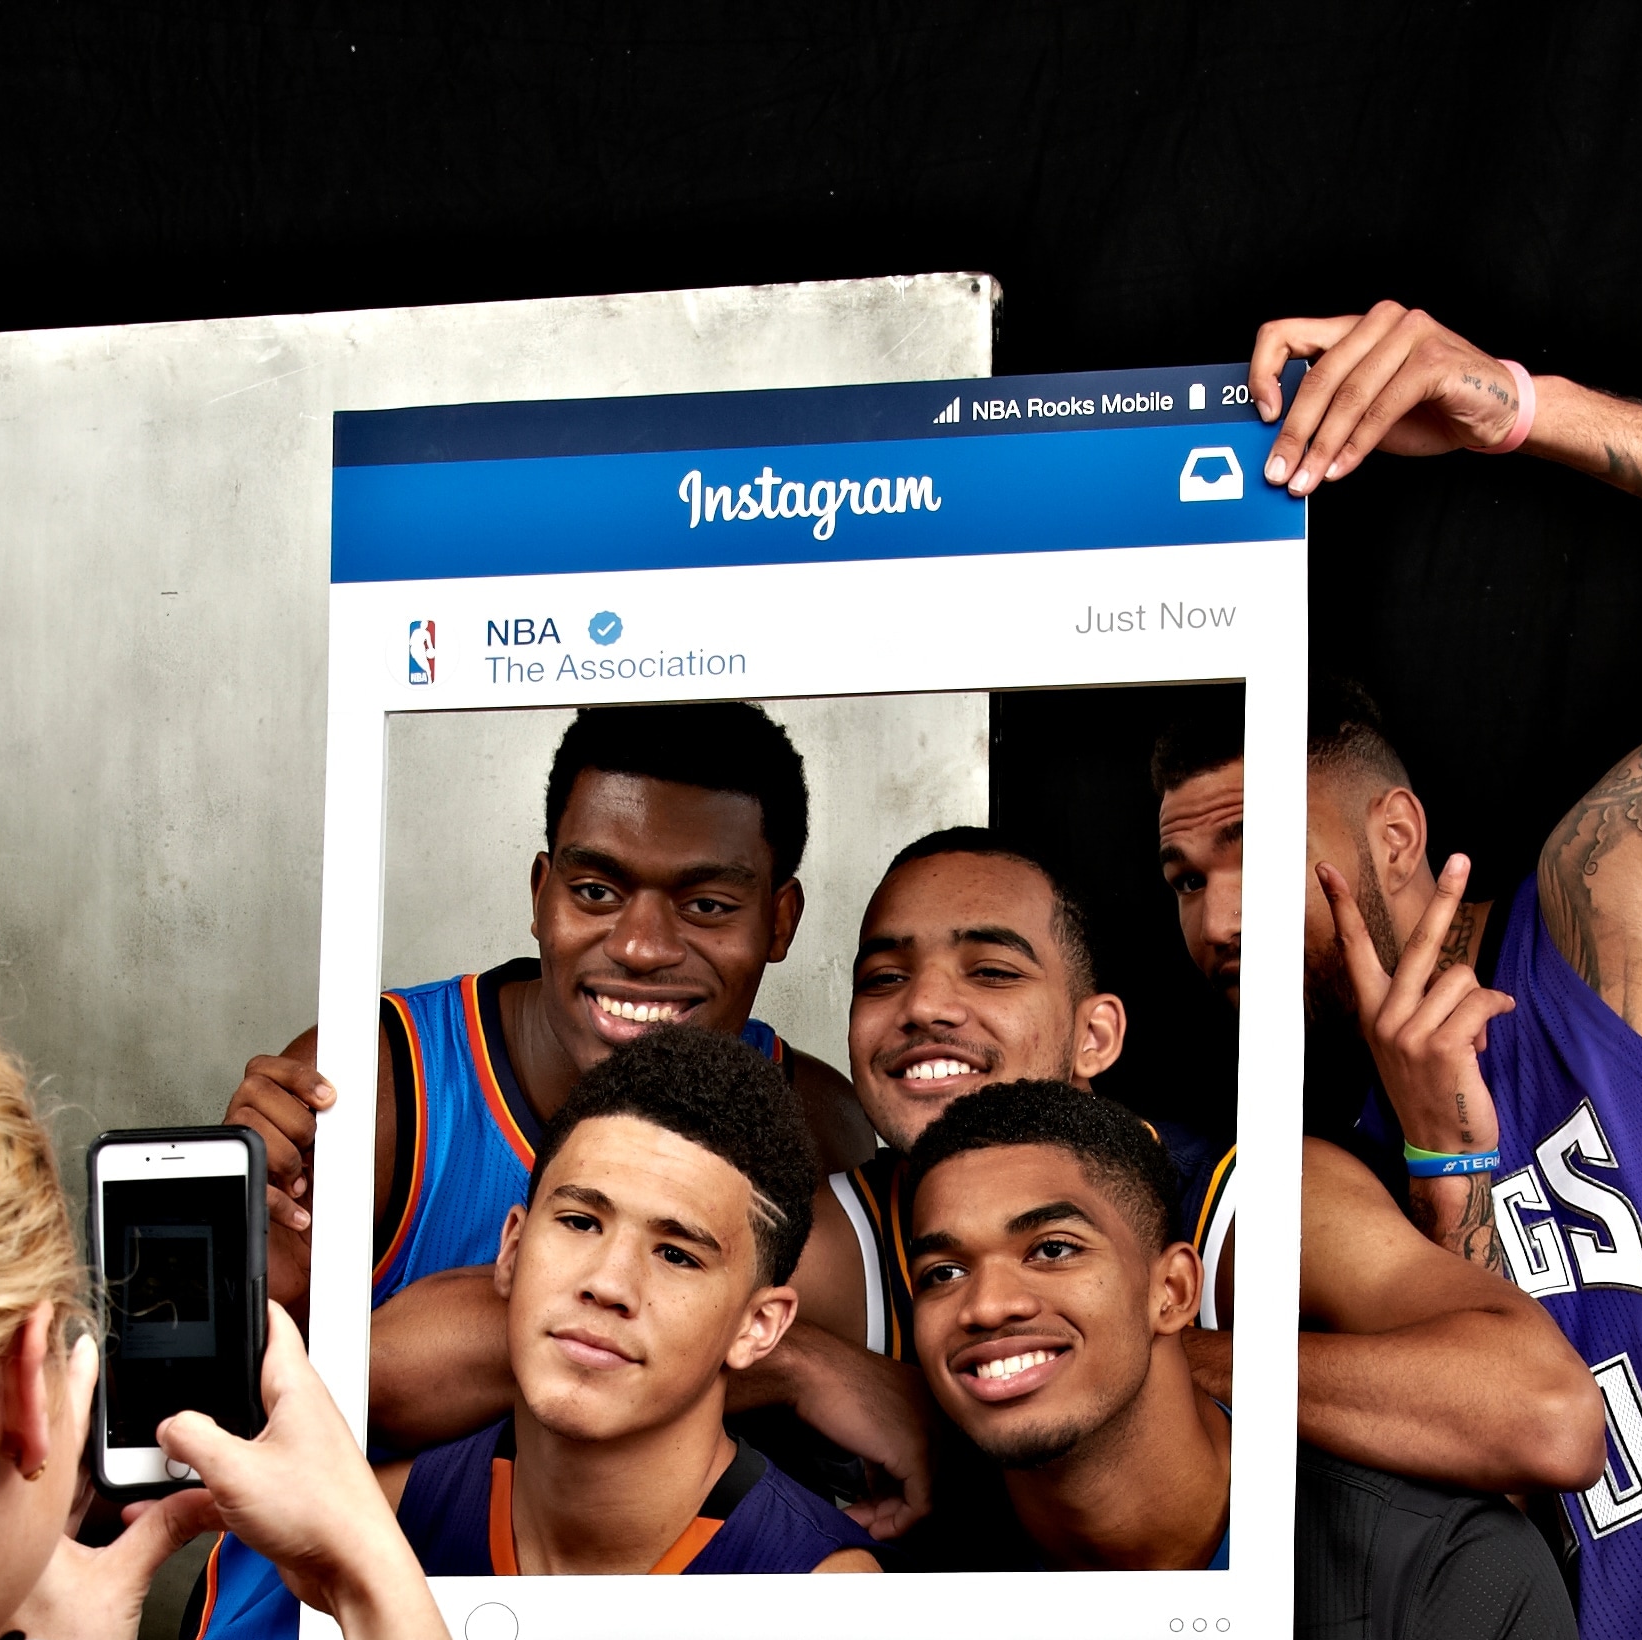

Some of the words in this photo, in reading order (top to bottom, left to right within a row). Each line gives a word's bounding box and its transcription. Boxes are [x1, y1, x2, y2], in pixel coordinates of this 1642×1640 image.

[972, 400, 1021, 421] NBA
[1028, 396, 1095, 418] Rooks
[1101, 391, 1173, 414] Mobile
[678, 465, 942, 541] Instagram
[487, 618, 561, 646] NBA
[1074, 604, 1147, 635] Just
[1159, 600, 1238, 630] Now
[410, 673, 427, 683] NBA
[485, 656, 545, 684] The
[555, 649, 747, 682] Association
